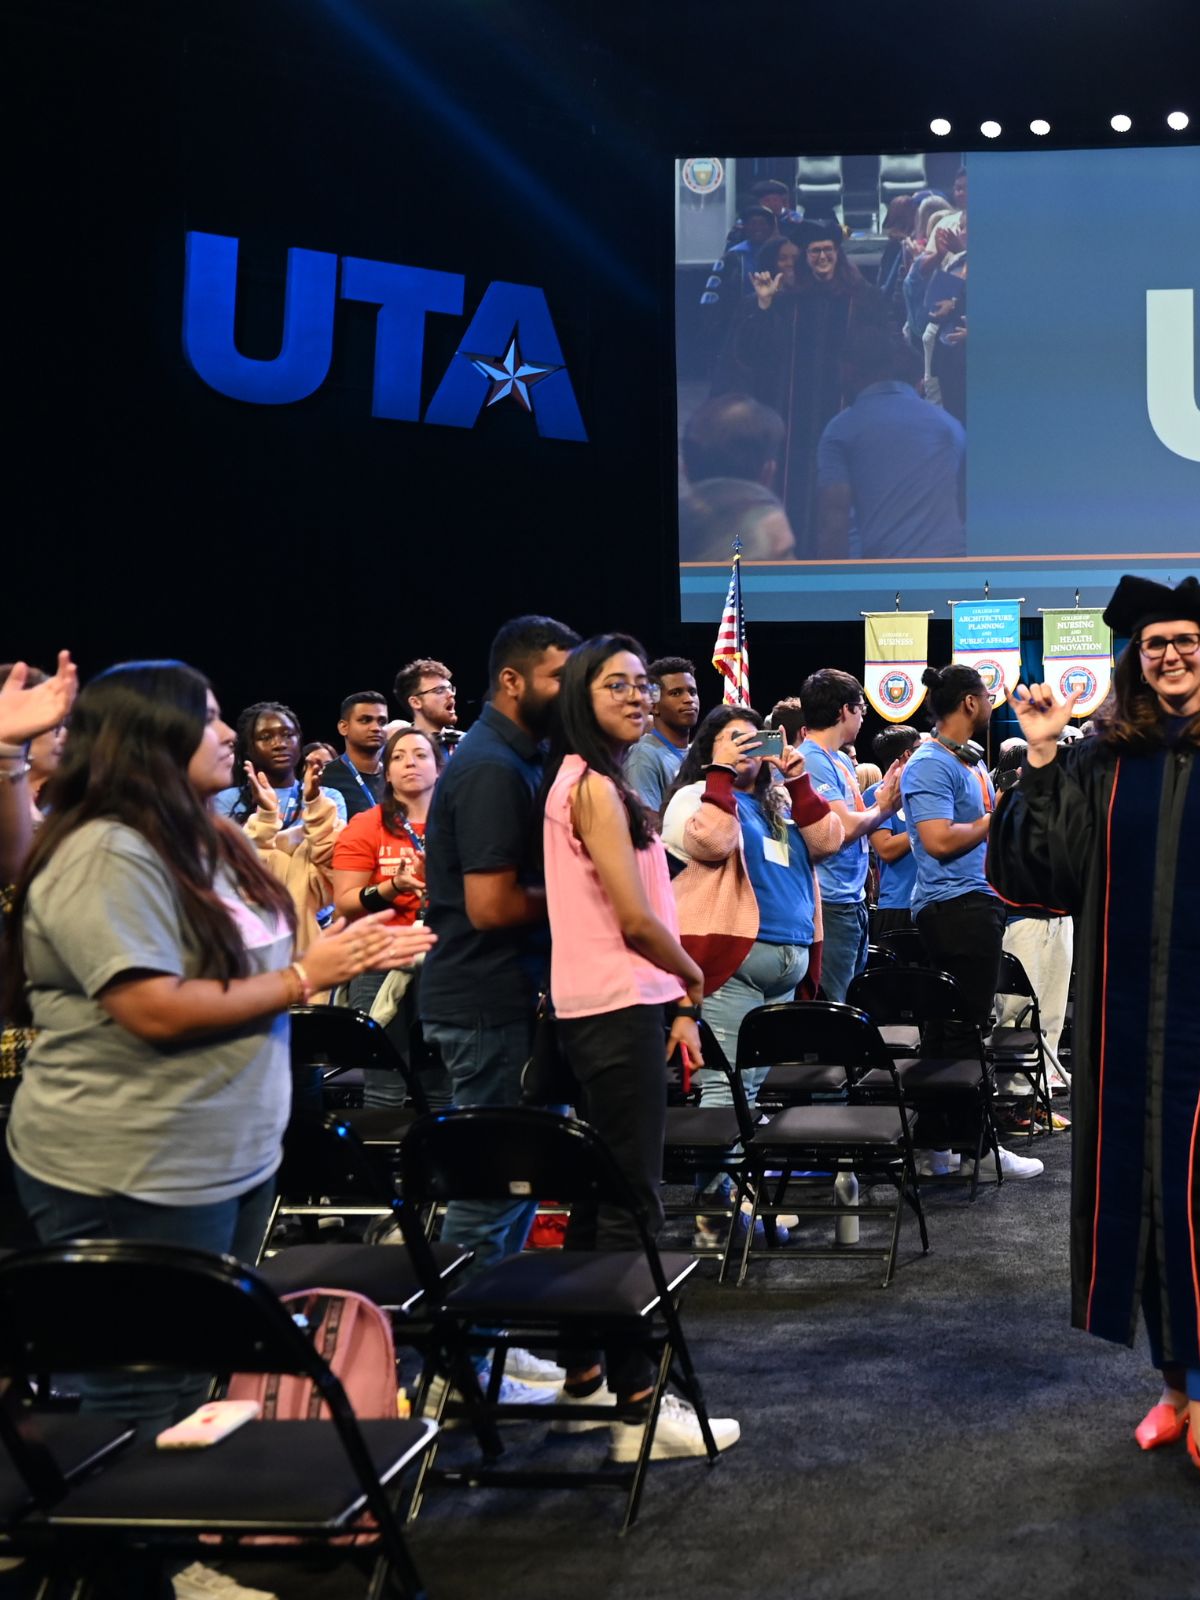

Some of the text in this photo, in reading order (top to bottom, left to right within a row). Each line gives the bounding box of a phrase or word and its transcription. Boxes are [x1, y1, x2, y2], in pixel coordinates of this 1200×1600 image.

[182, 230, 589, 442] UTA
[958, 614, 1015, 622] ARCHITECTURE,
[967, 622, 1005, 630] PLANNING
[1056, 620, 1094, 630] NURSING
[878, 638, 914, 646] BUSINESS
[1059, 635, 1093, 643] HEALTH
[1050, 643, 1102, 652] INNOVATION
